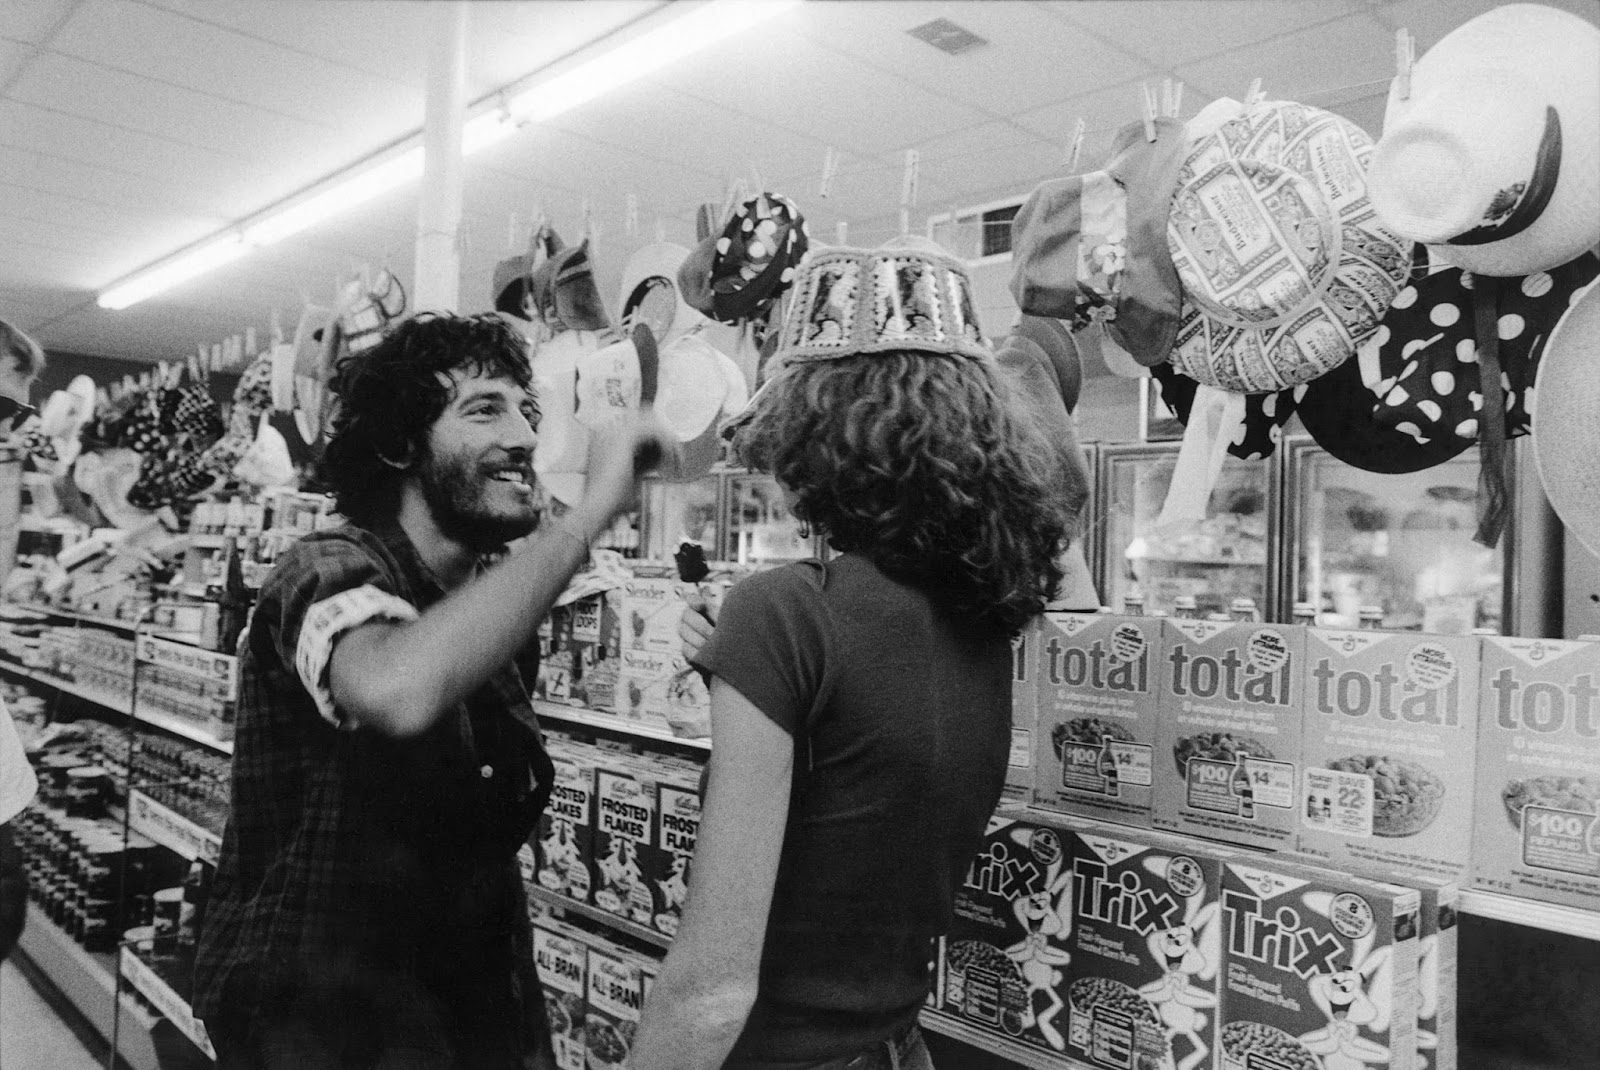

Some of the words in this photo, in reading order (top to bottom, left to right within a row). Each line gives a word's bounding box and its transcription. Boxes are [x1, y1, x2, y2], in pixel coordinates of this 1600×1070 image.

[1315, 145, 1342, 200] Budweiser
[1208, 194, 1247, 250] Budweiser
[1345, 274, 1386, 313] Budweiser
[1046, 637, 1148, 692] total
[1169, 644, 1292, 705] total
[1313, 658, 1459, 726] total
[554, 785, 586, 804] OSTED
[601, 796, 648, 823] FROSTED
[604, 814, 644, 838] FLAKES
[663, 813, 700, 836] FROST
[964, 842, 1041, 900] rix
[1073, 856, 1179, 936] Trix
[1222, 888, 1345, 980] Trix
